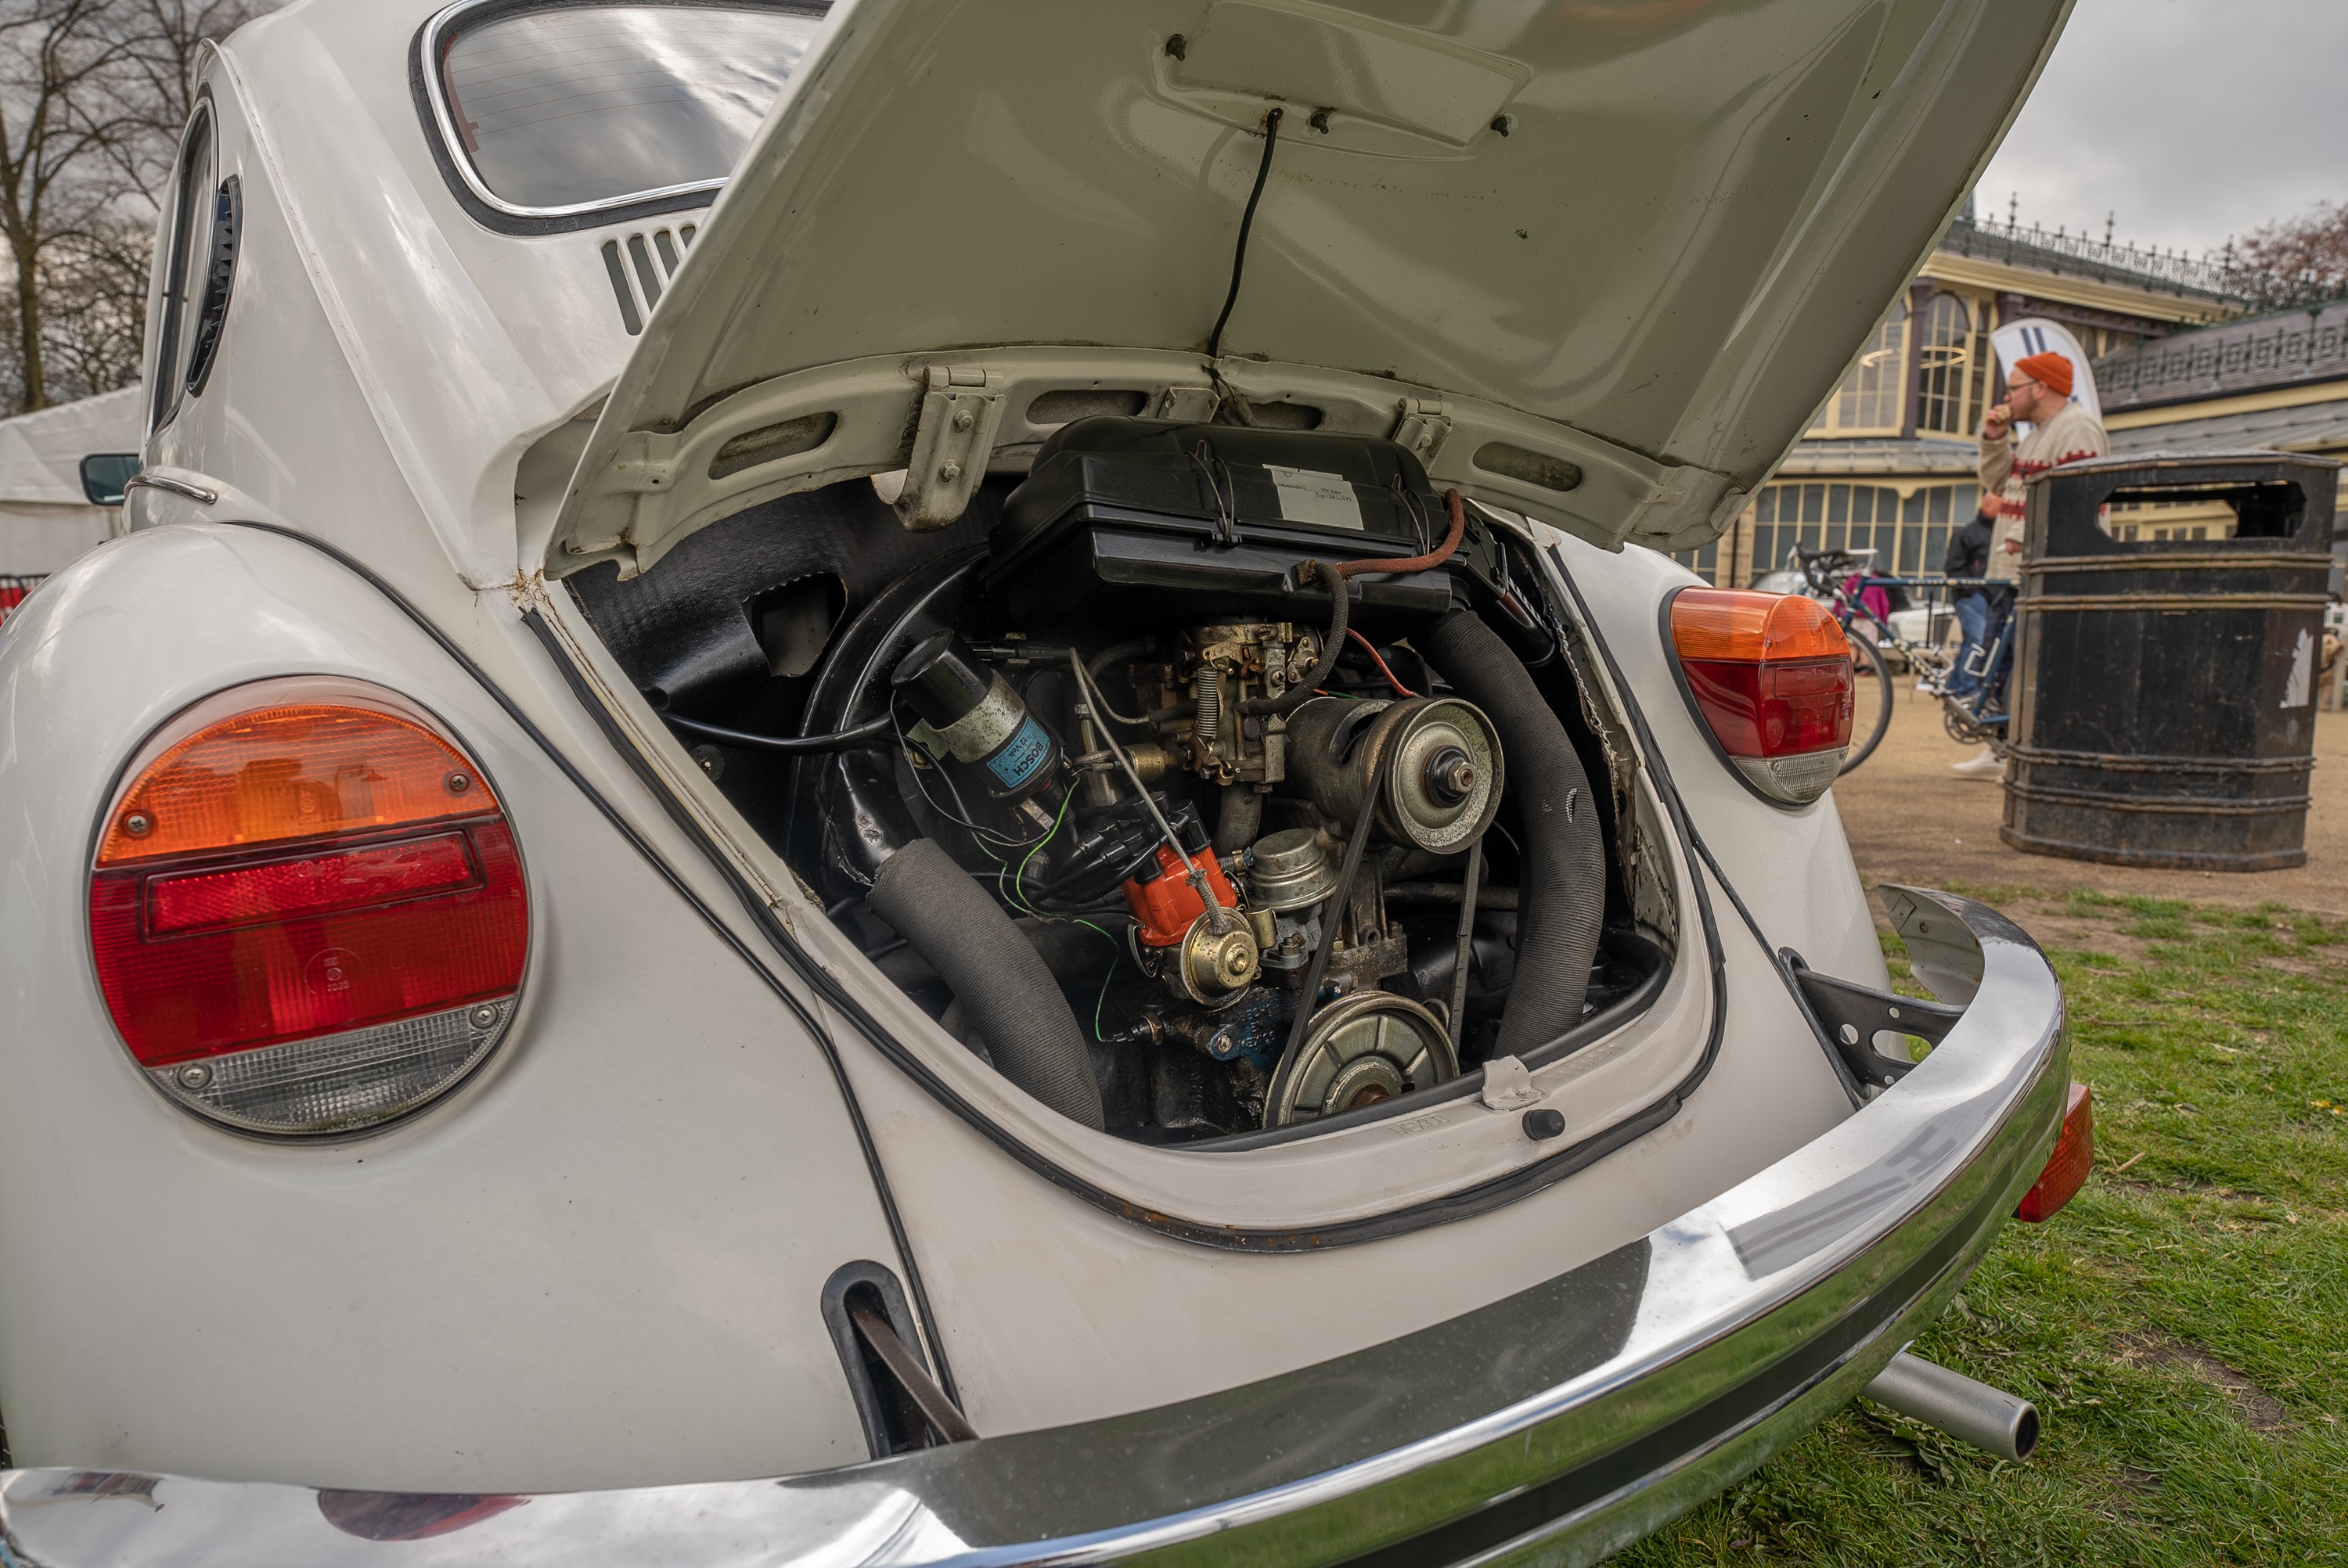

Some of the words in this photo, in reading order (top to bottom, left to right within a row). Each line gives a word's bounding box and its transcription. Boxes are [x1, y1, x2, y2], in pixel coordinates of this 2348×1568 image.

[1019, 736, 1028, 746] 12
[1007, 745, 1022, 757] Volt
[1012, 740, 1044, 776] BOSCH
[1388, 1113, 1450, 1136] MEXICO
